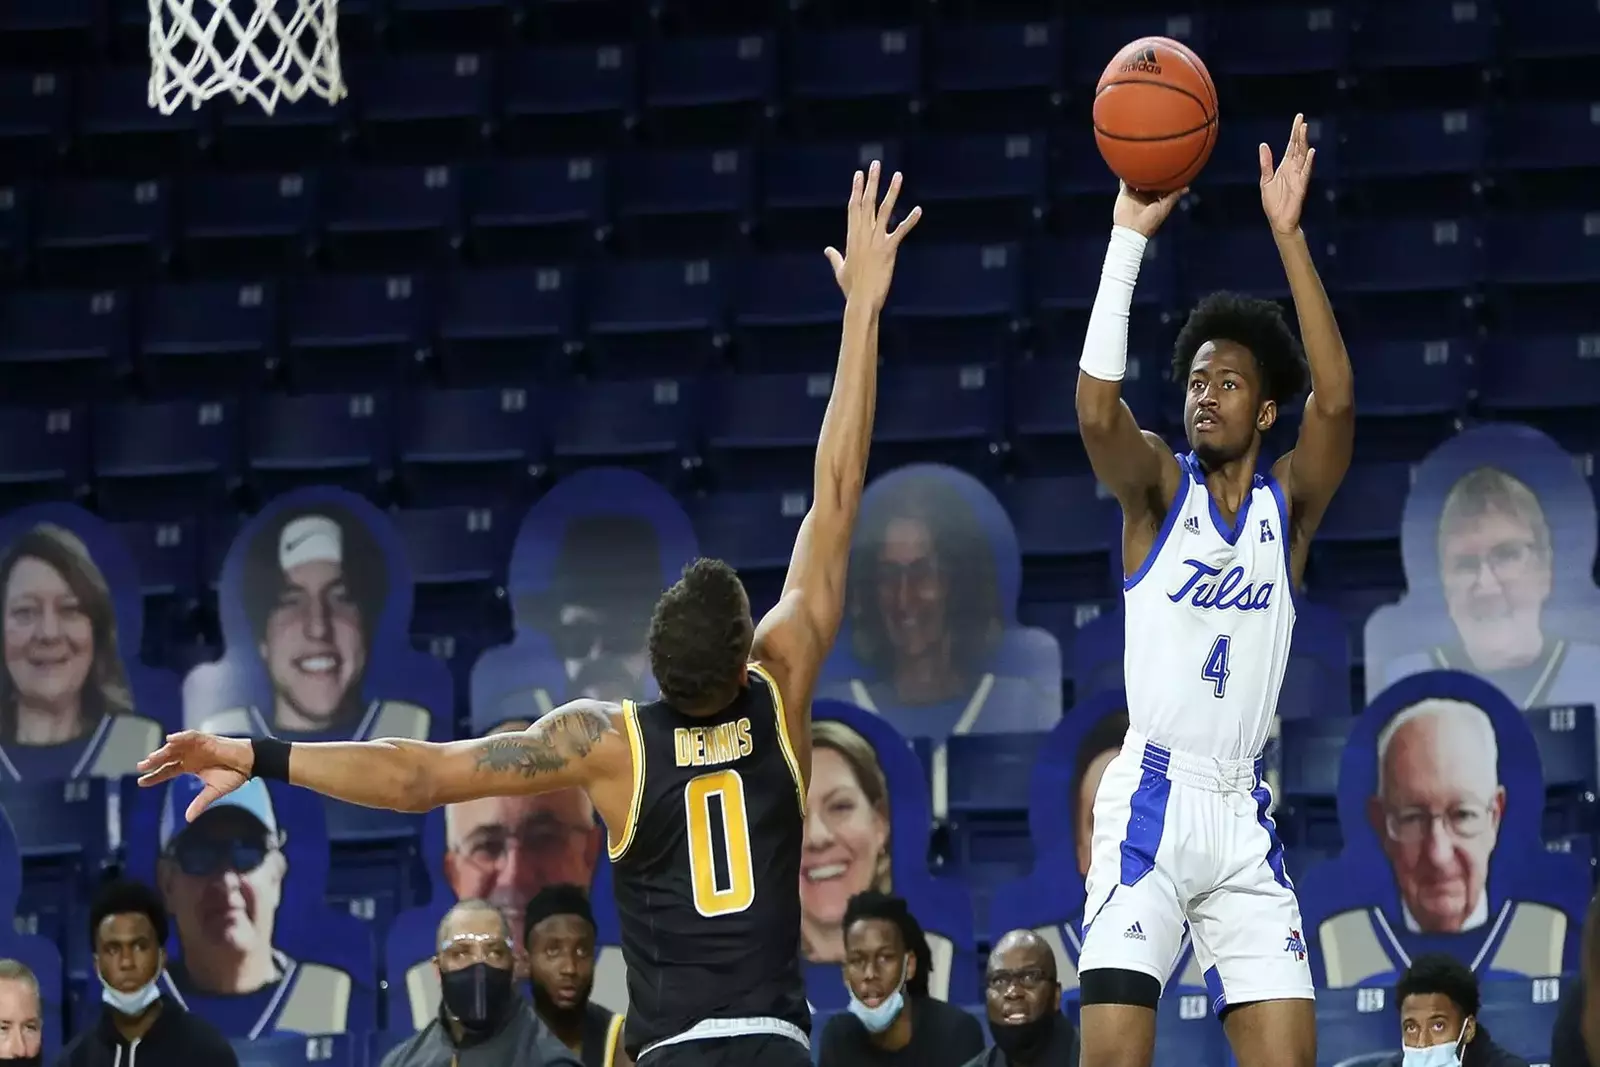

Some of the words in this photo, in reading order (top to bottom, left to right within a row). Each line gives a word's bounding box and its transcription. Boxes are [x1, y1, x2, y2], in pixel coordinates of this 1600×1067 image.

[1167, 559, 1275, 610] Tulsa
[1201, 634, 1231, 699] 4
[674, 718, 753, 767] DENNIS
[684, 769, 756, 917] 0
